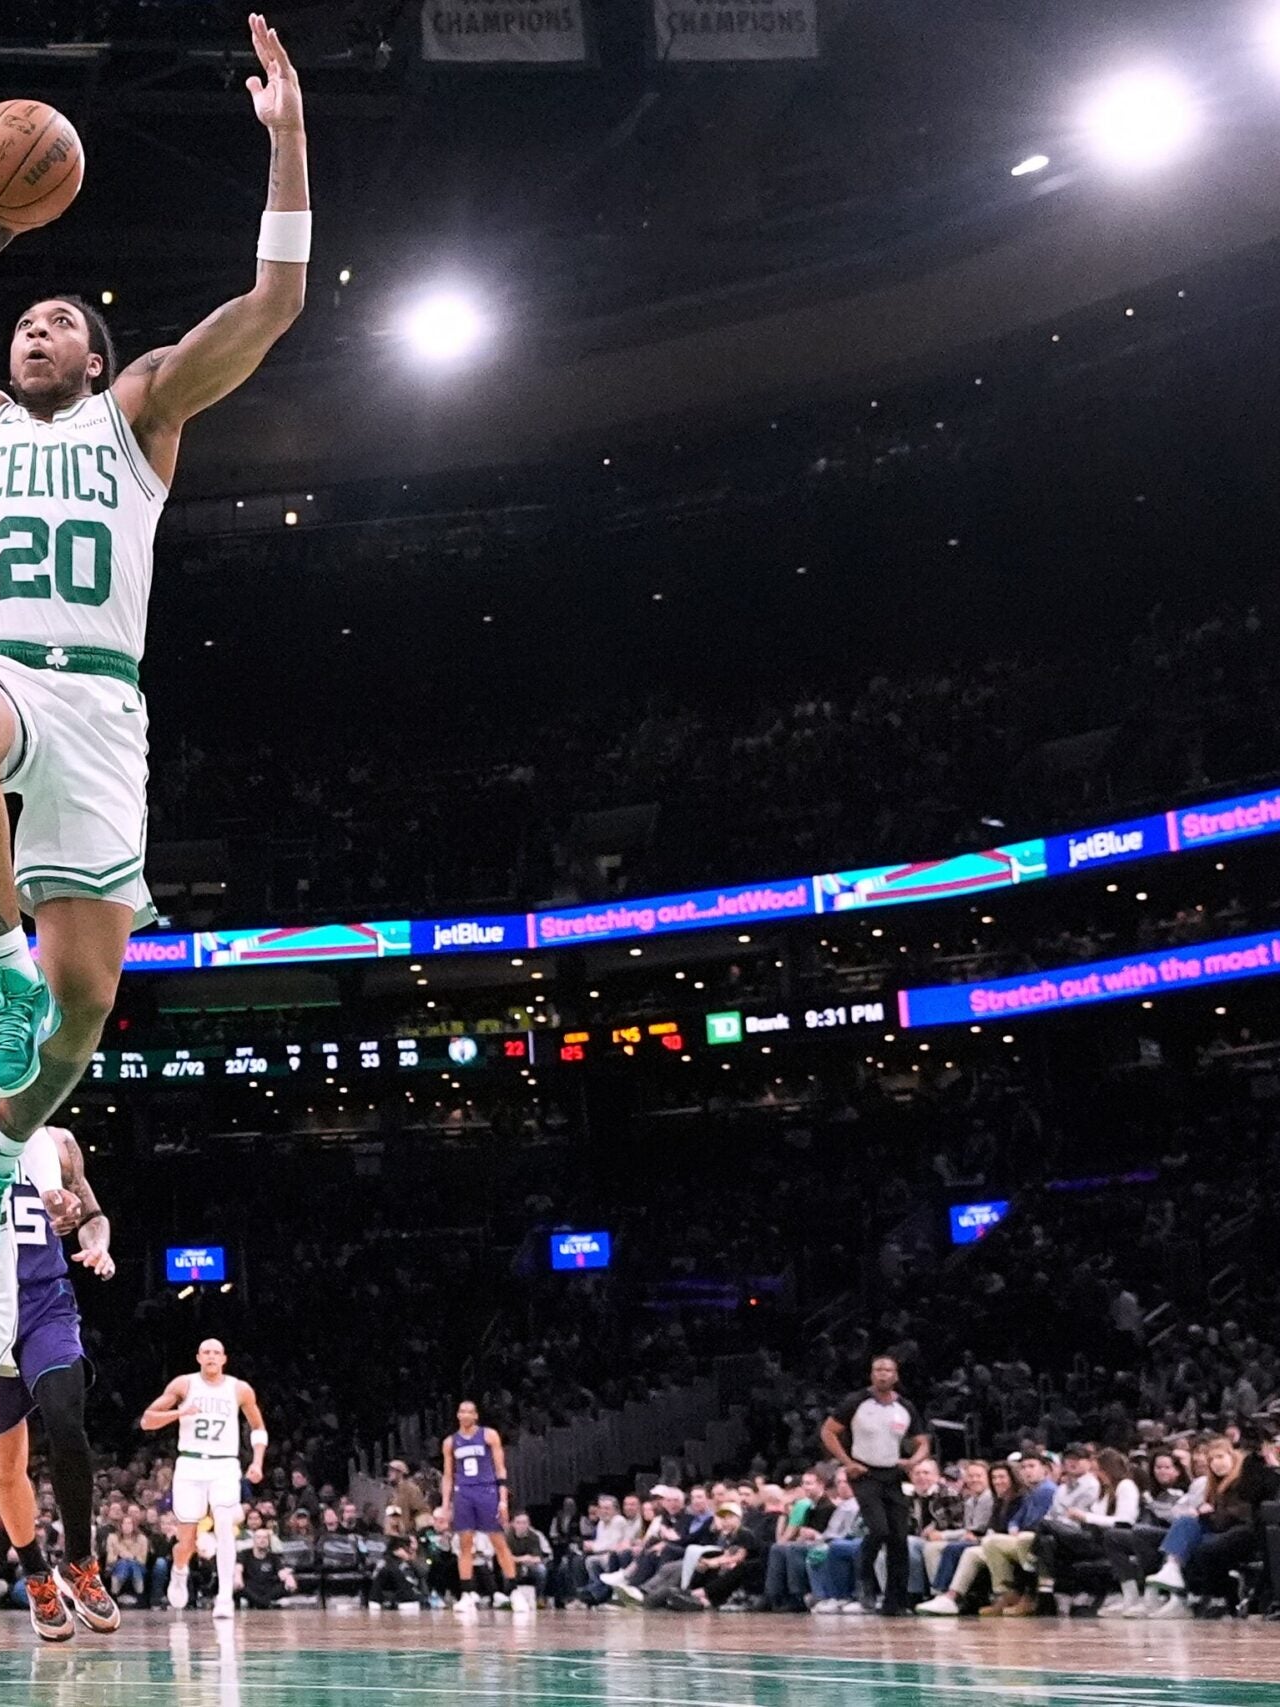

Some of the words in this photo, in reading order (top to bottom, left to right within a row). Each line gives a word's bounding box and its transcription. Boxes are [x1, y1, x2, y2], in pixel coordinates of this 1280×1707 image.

[432, 8, 573, 34] CHAMPIONS
[1069, 831, 1143, 868] jetBlue
[433, 922, 504, 950] jetBlue
[540, 908, 655, 939] Stretching
[970, 979, 1058, 1012] Stretch
[1060, 972, 1100, 998] out
[1102, 962, 1157, 991] with
[1158, 956, 1202, 982] the
[1204, 943, 1269, 974] most
[710, 1017, 739, 1038] TD
[745, 1014, 789, 1033] Bank
[805, 1006, 846, 1028] 9:31
[851, 1002, 884, 1023] PM
[93, 1064, 103, 1078] 2
[120, 1064, 148, 1078] 51.1
[162, 1061, 205, 1077] 47/92
[225, 1058, 268, 1074] 23/50
[289, 1056, 301, 1071] 9
[326, 1054, 338, 1069] 8
[361, 1053, 380, 1068] 33
[399, 1051, 419, 1066] 50
[559, 1241, 600, 1254] ULTRA
[175, 1255, 214, 1267] ULTRA
[195, 1418, 226, 1441] 27
[463, 1457, 479, 1477] 9
